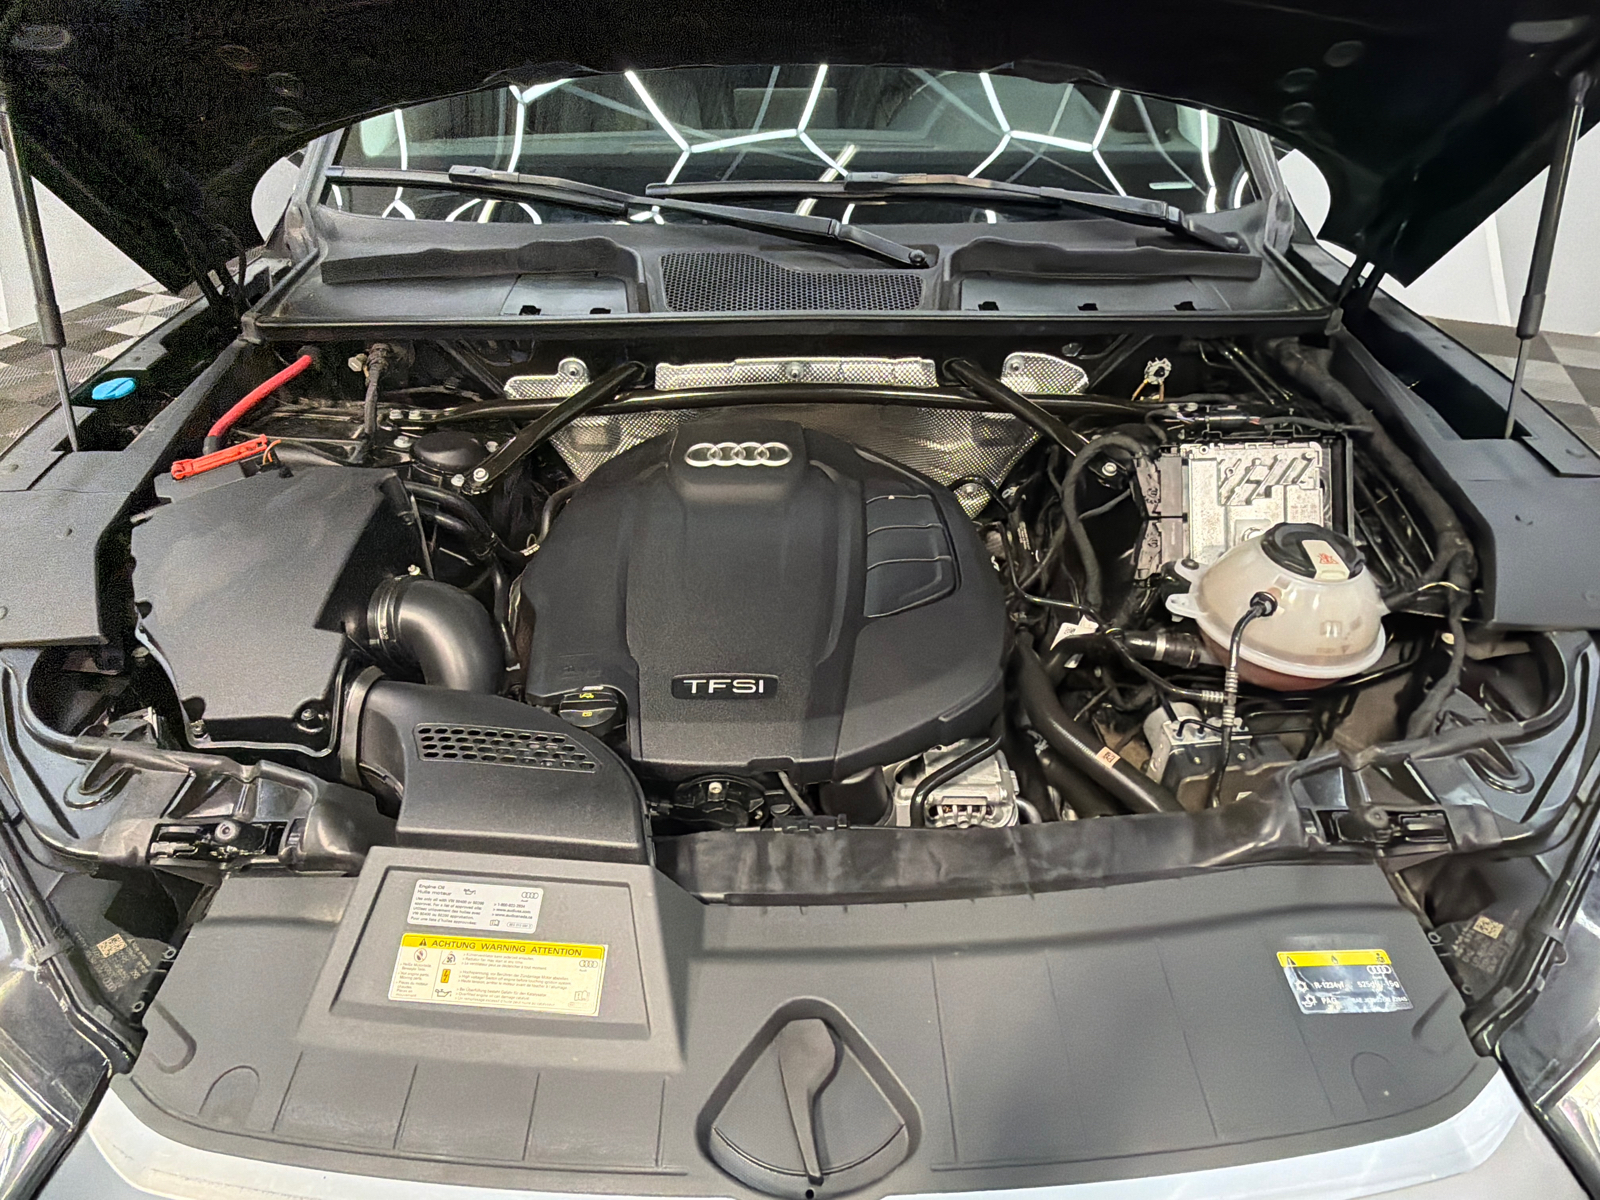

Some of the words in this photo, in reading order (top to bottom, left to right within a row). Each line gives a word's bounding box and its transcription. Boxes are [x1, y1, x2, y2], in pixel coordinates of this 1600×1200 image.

[683, 679, 764, 694] TFSI
[431, 940, 476, 950] ACHTUNG
[480, 943, 526, 953] WARNING
[530, 946, 582, 956] ATTENTION
